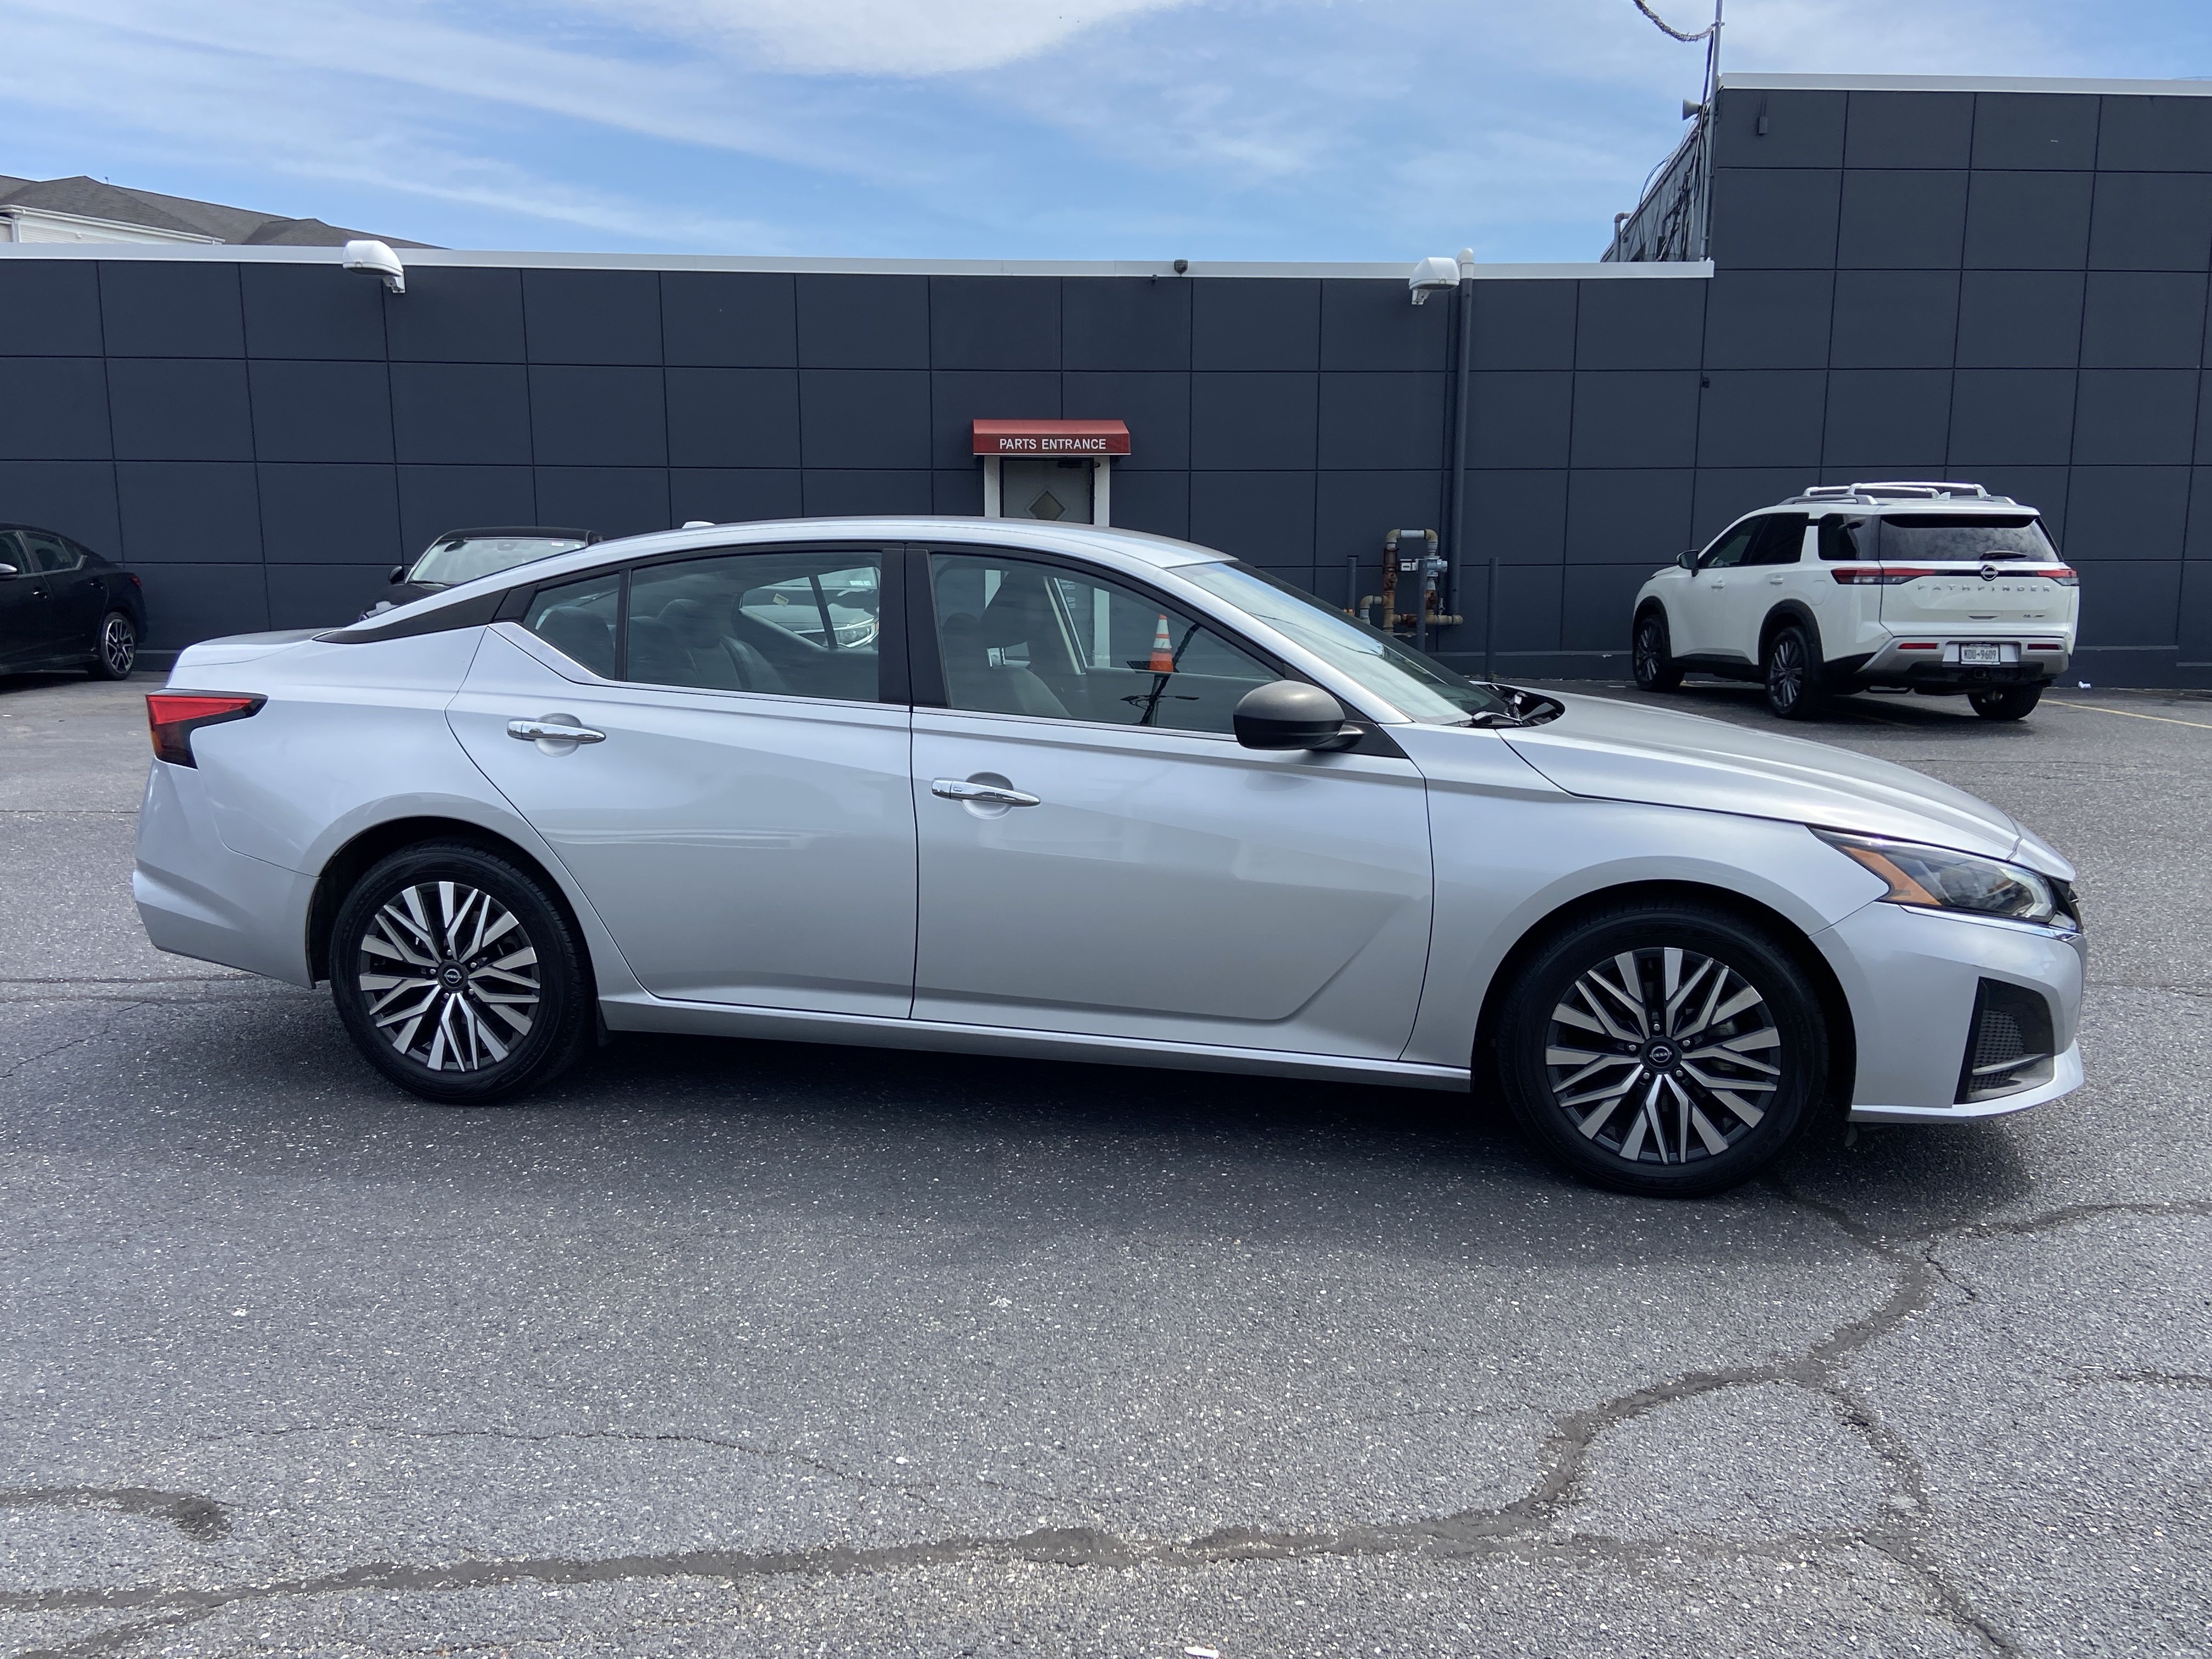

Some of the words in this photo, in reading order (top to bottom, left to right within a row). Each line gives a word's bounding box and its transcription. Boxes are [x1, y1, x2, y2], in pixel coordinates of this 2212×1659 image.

[1000, 438, 1037, 450] PARTS
[1041, 438, 1107, 450] ENTRANCE
[1917, 584, 2051, 592] PATHFINDER
